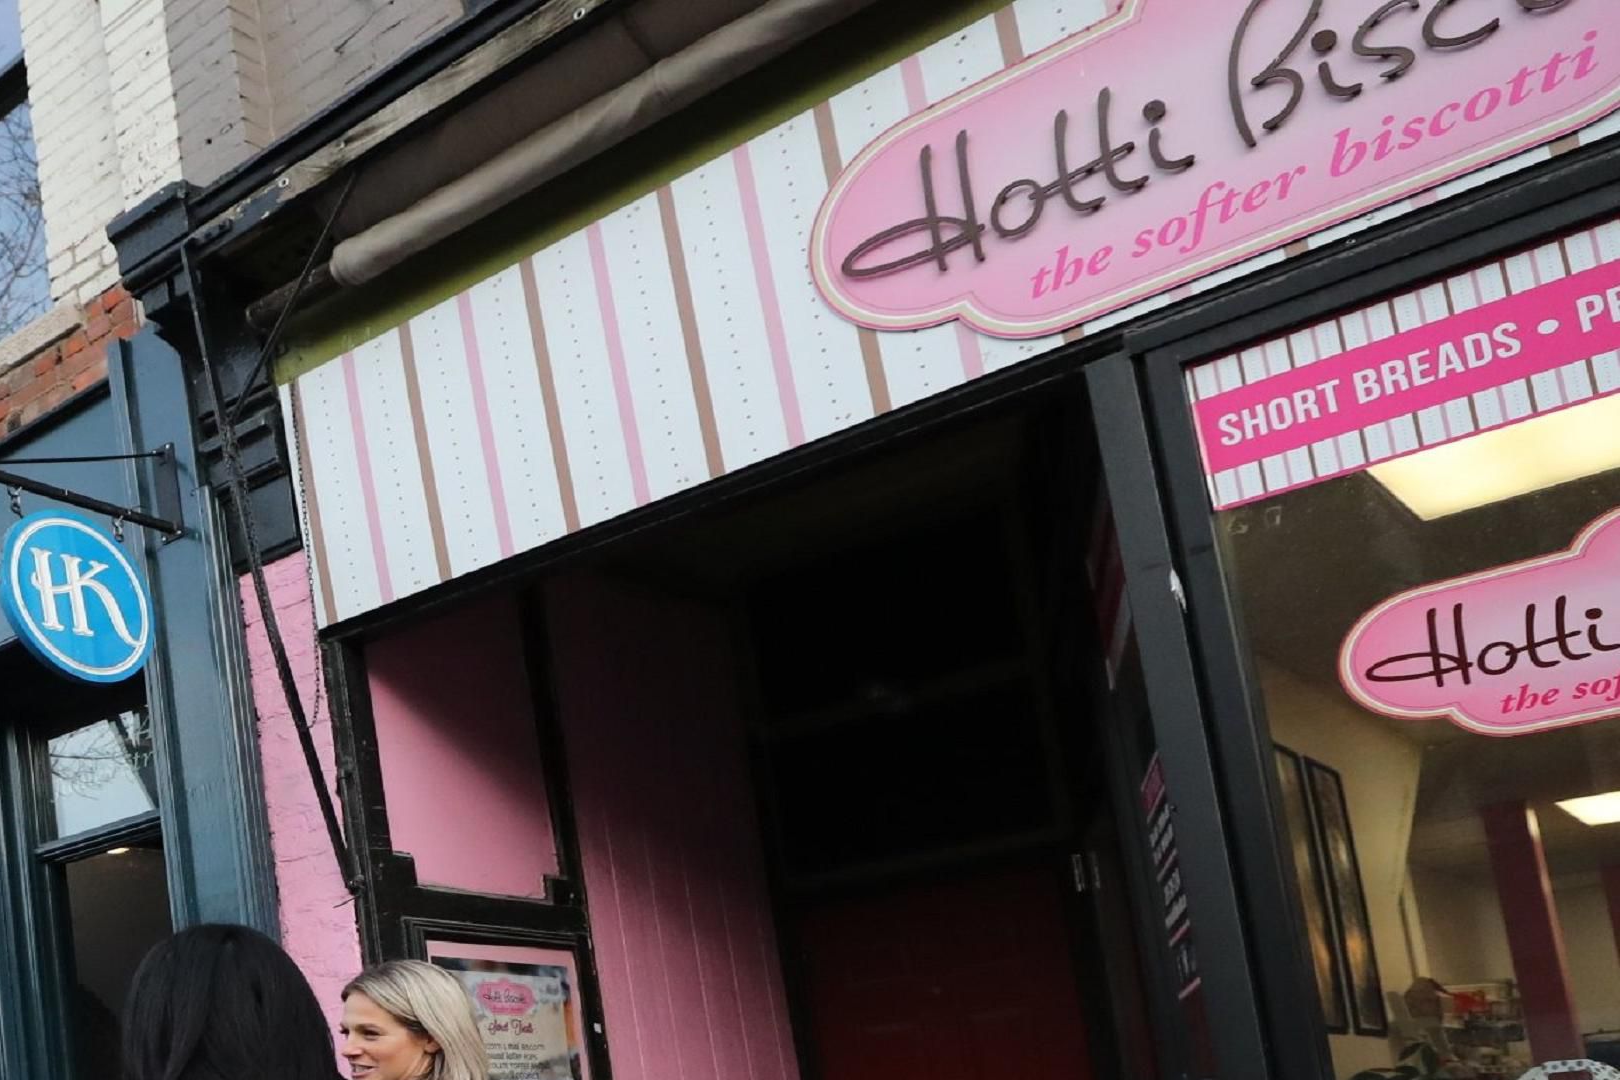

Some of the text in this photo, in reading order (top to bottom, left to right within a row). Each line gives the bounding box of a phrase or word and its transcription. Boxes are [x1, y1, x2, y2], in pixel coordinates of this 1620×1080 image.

[842, 0, 1572, 278] Hotti Bisc
[1030, 29, 1599, 299] the softer biscotti
[1217, 378, 1340, 446] SHORT
[1352, 321, 1522, 404] BREADS
[1365, 595, 1620, 688] Hotti
[1500, 683, 1560, 714] the
